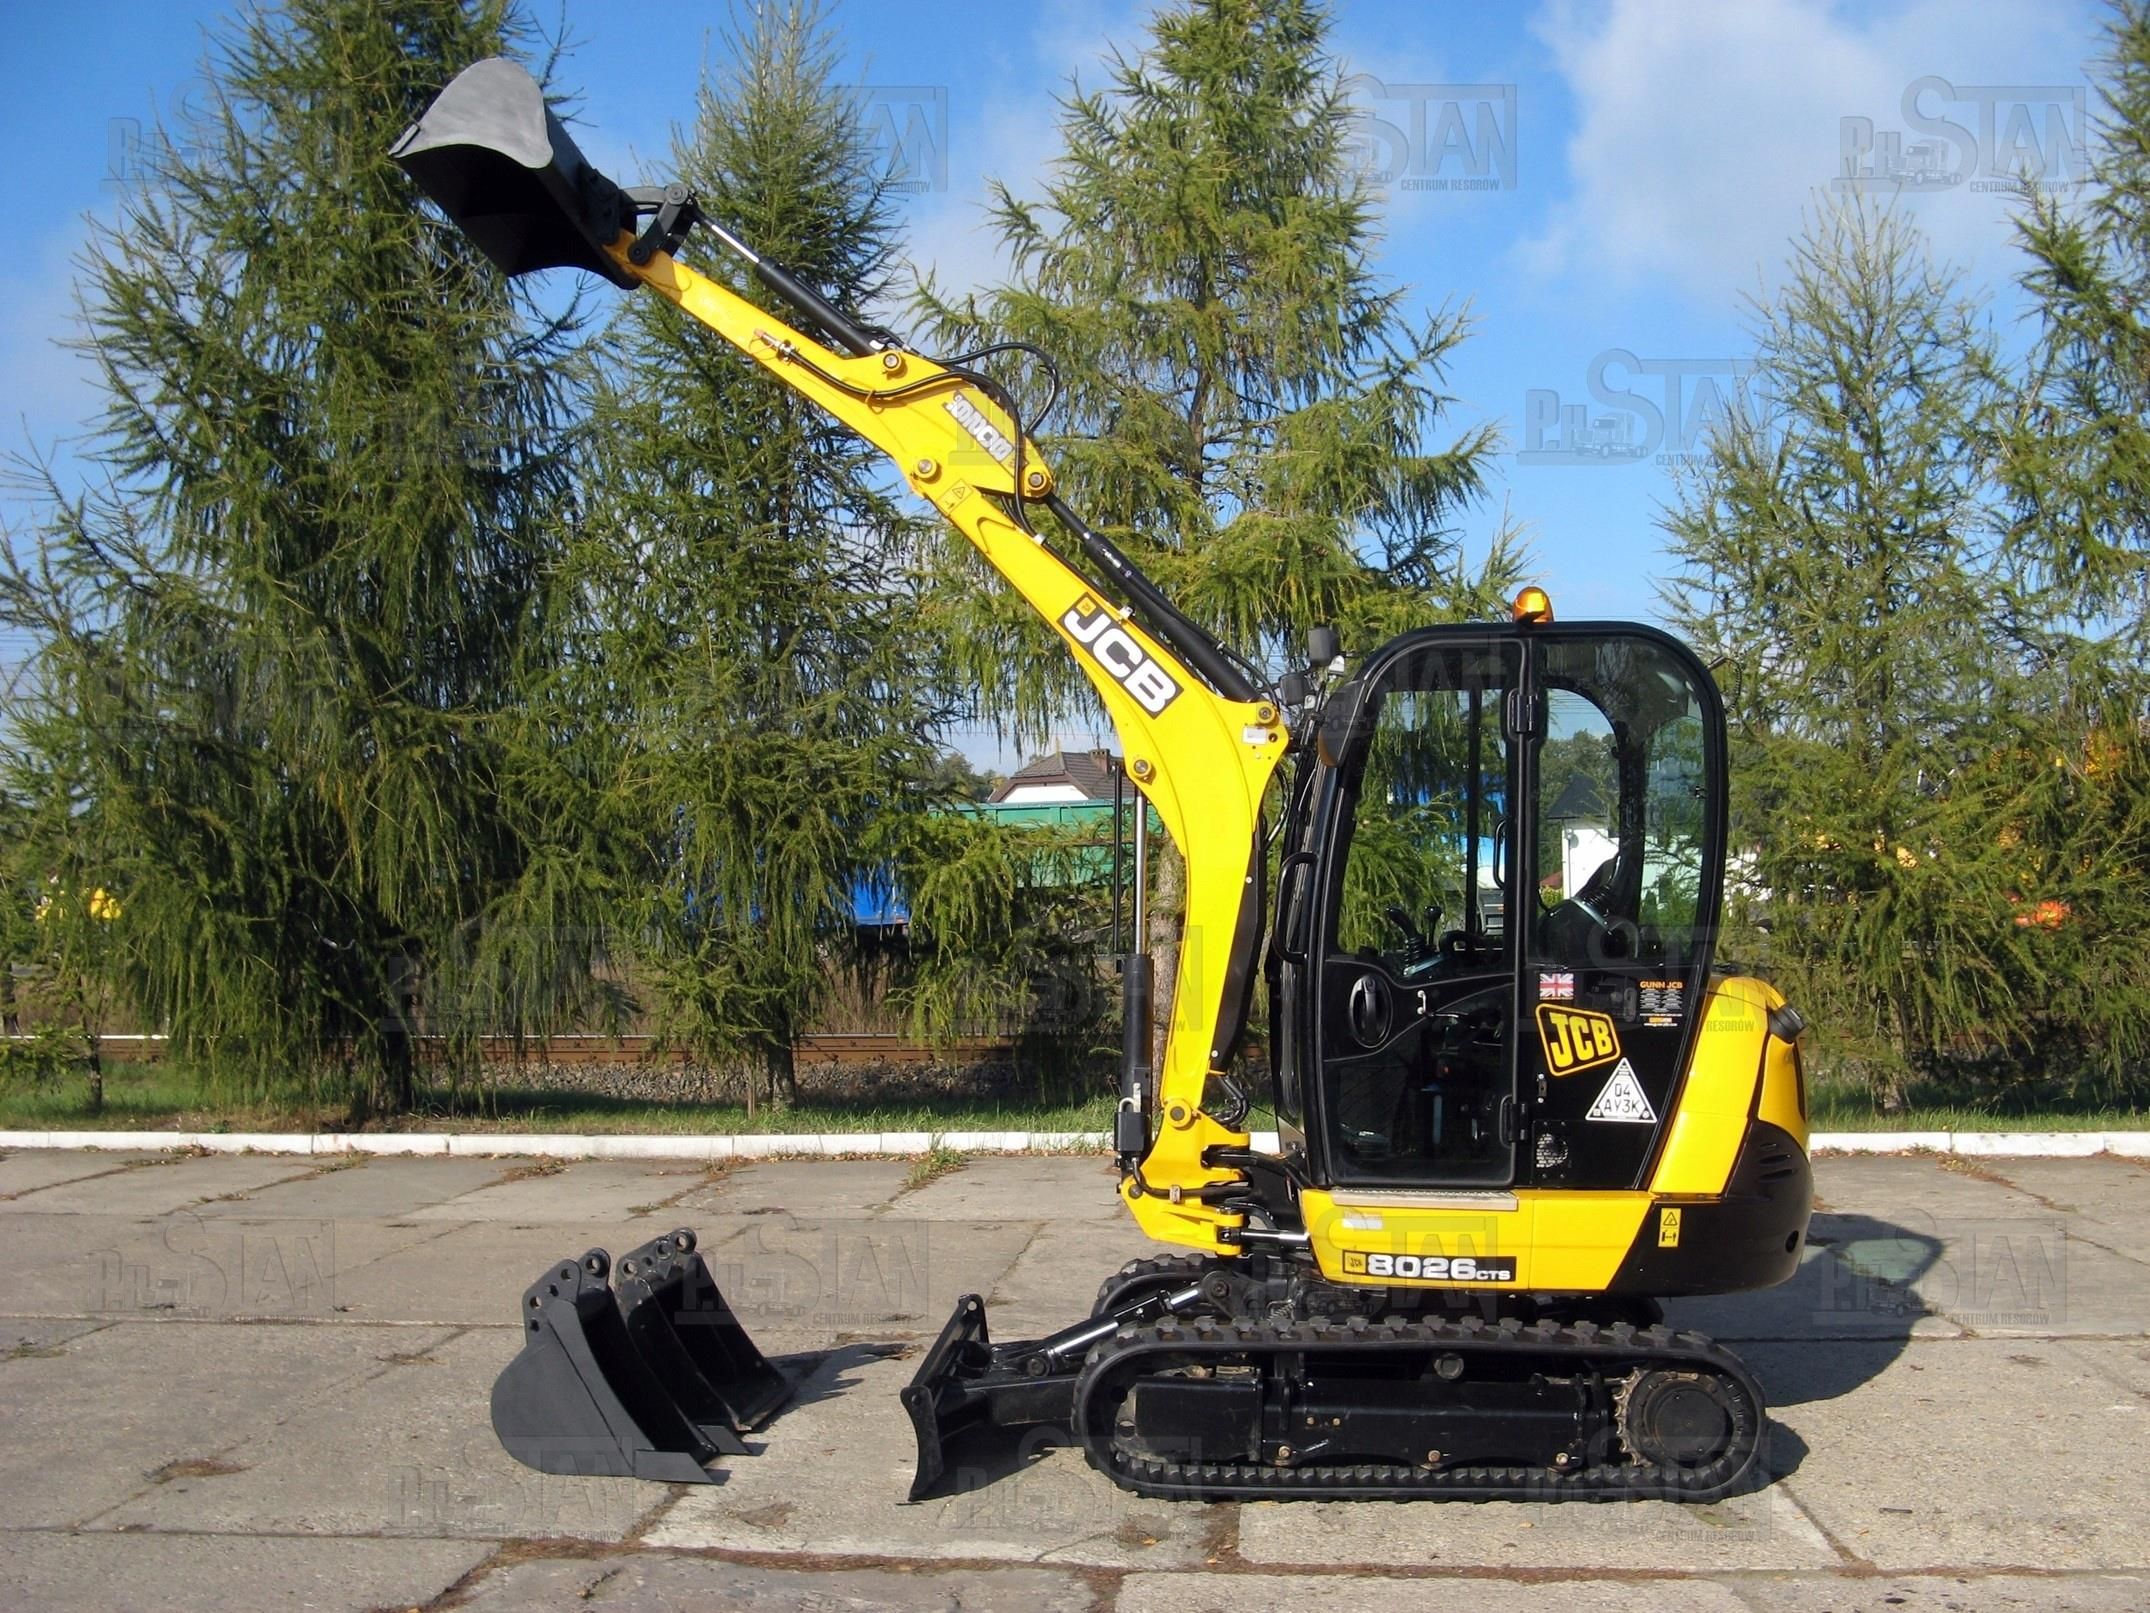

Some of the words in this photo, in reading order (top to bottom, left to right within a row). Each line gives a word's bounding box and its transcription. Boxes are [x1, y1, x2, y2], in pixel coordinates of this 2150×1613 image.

[1064, 609, 1177, 713] JCB
[1640, 981, 1665, 989] GUNN
[1666, 981, 1683, 989] JCB
[1549, 1011, 1613, 1068] JCB
